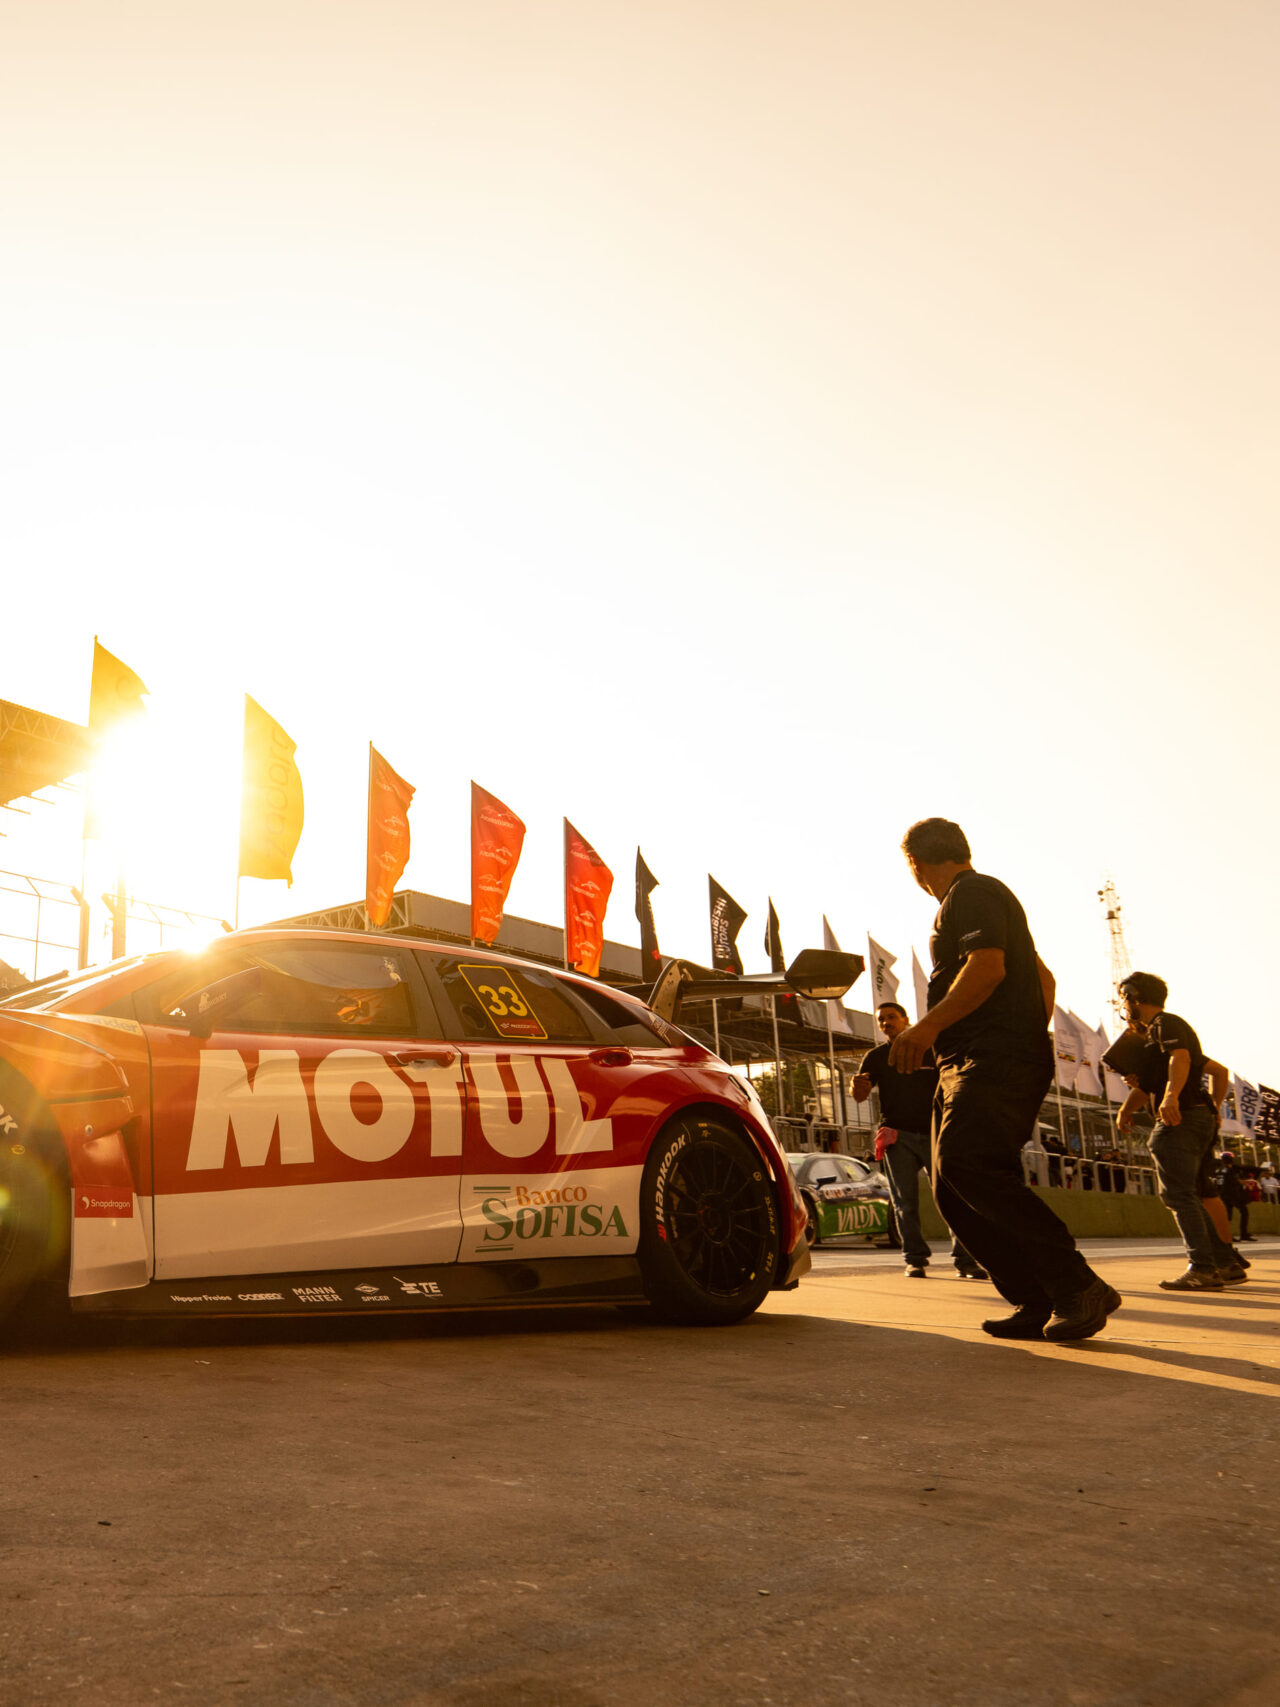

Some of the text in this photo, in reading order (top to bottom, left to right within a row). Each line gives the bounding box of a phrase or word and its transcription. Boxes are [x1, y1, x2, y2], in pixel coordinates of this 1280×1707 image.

[478, 984, 528, 1017] 33
[186, 1049, 614, 1171] MOTUL
[90, 1199, 131, 1210] Snapdragon
[516, 1185, 588, 1207] Banco
[483, 1197, 630, 1242] SOFISA
[837, 1204, 882, 1232] VALDA
[291, 1286, 337, 1296] MANN
[298, 1293, 343, 1303] FILTER
